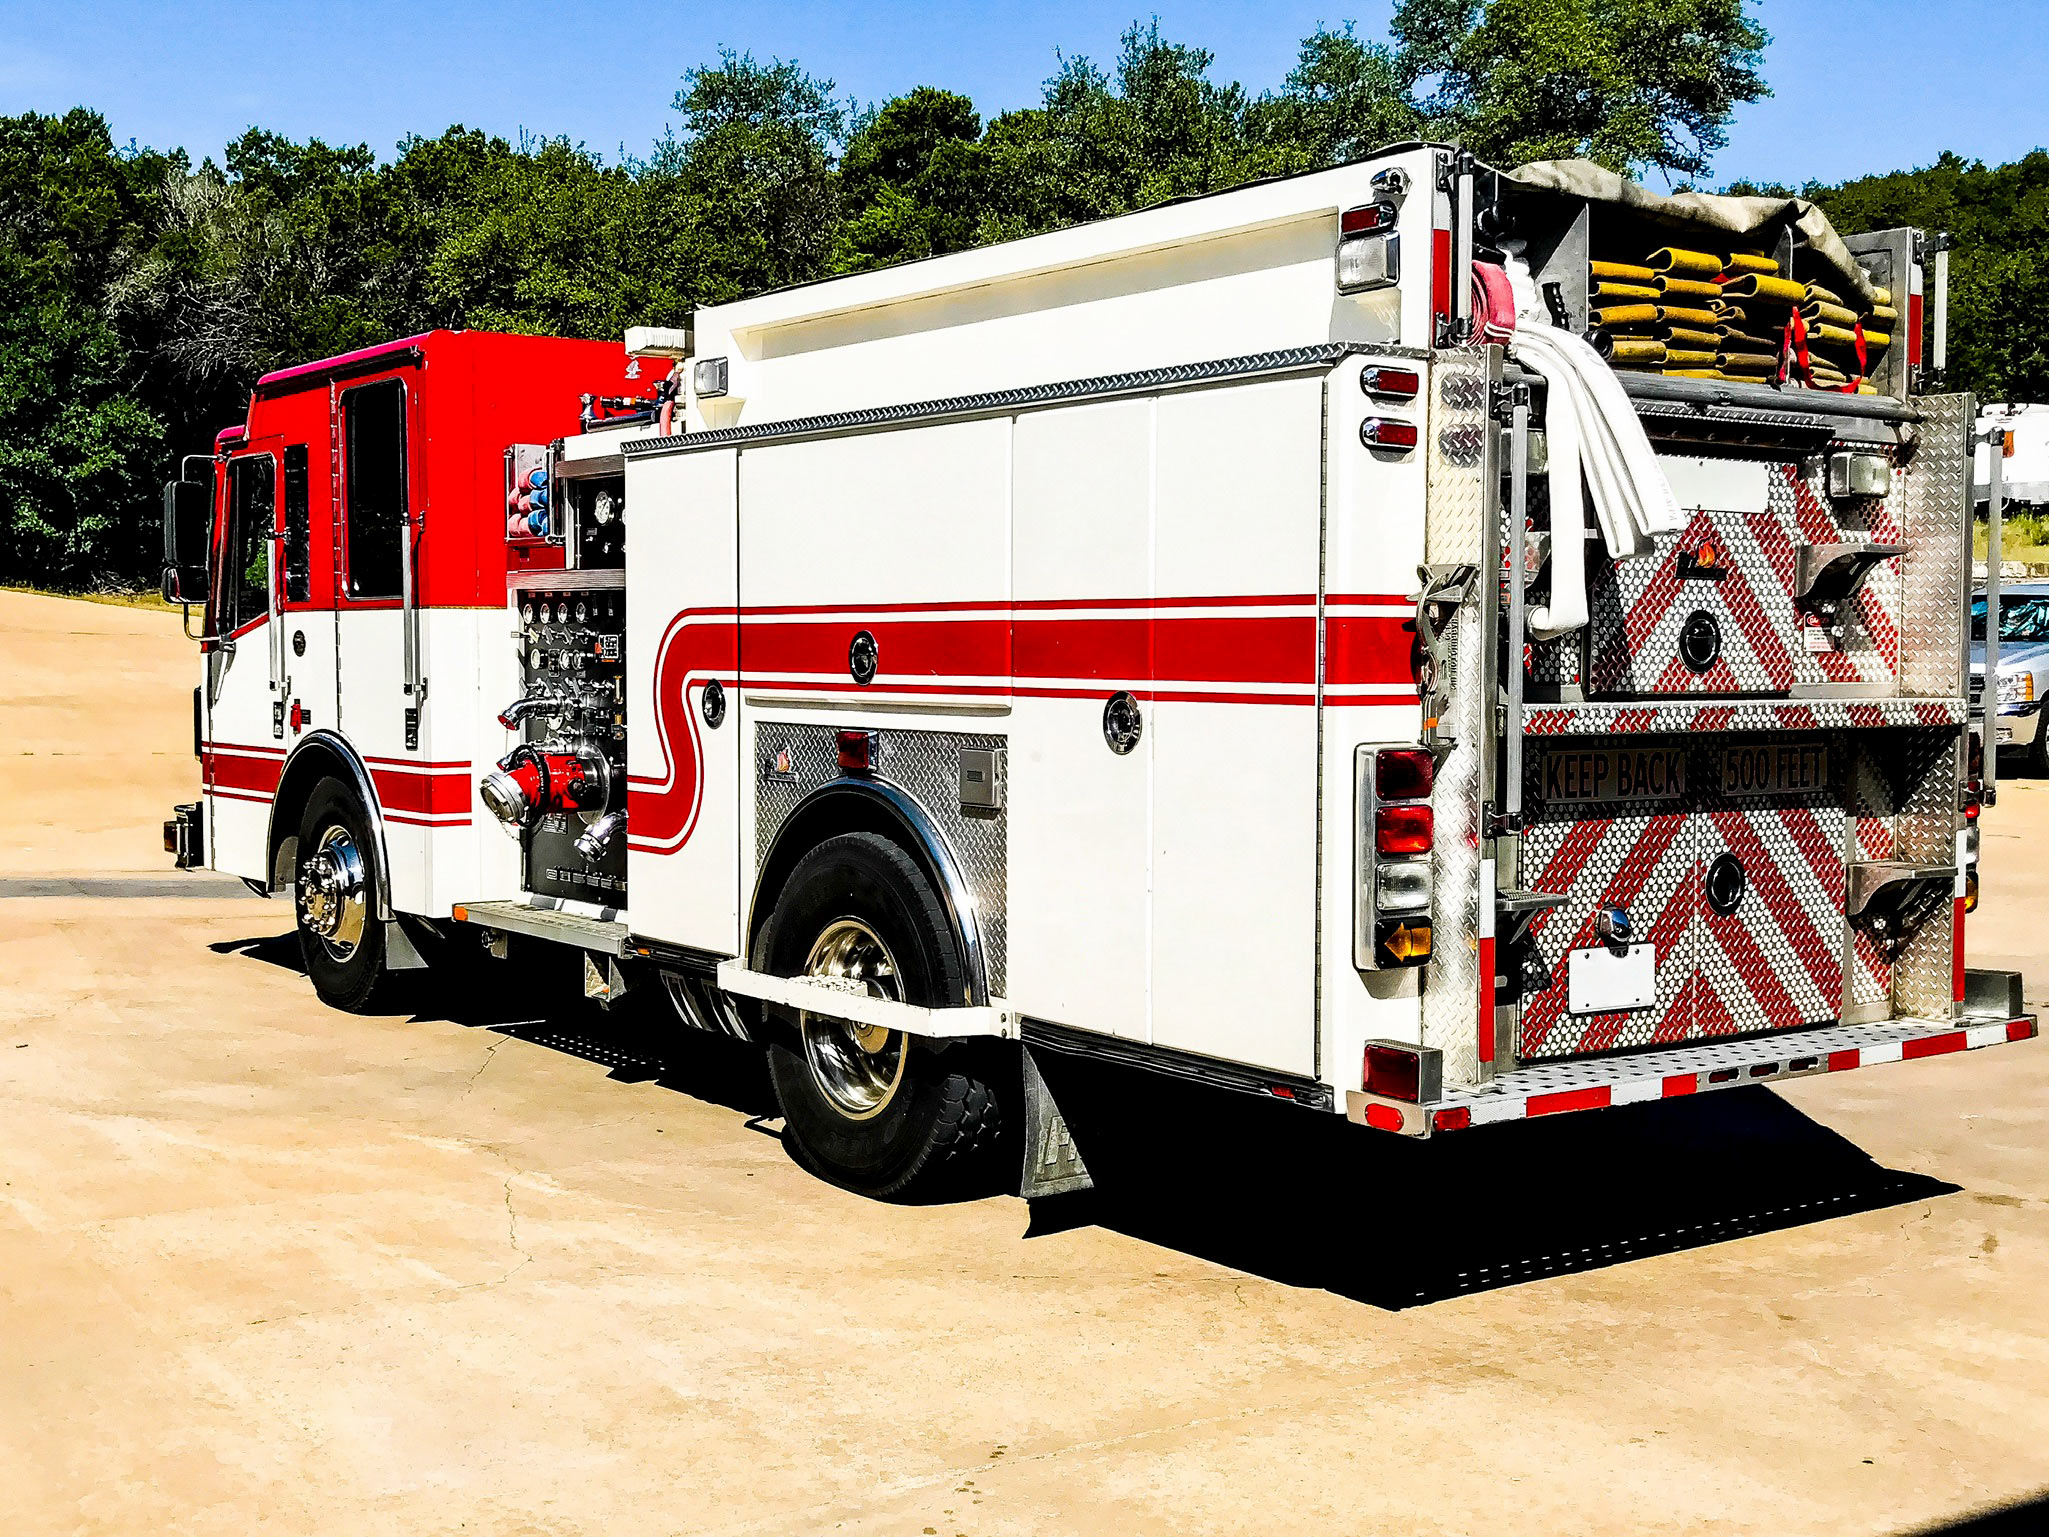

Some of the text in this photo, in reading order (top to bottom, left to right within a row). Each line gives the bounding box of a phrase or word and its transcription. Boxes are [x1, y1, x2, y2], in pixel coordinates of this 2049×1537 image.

[1549, 747, 1823, 799] KEEP BACK 500 FEET
